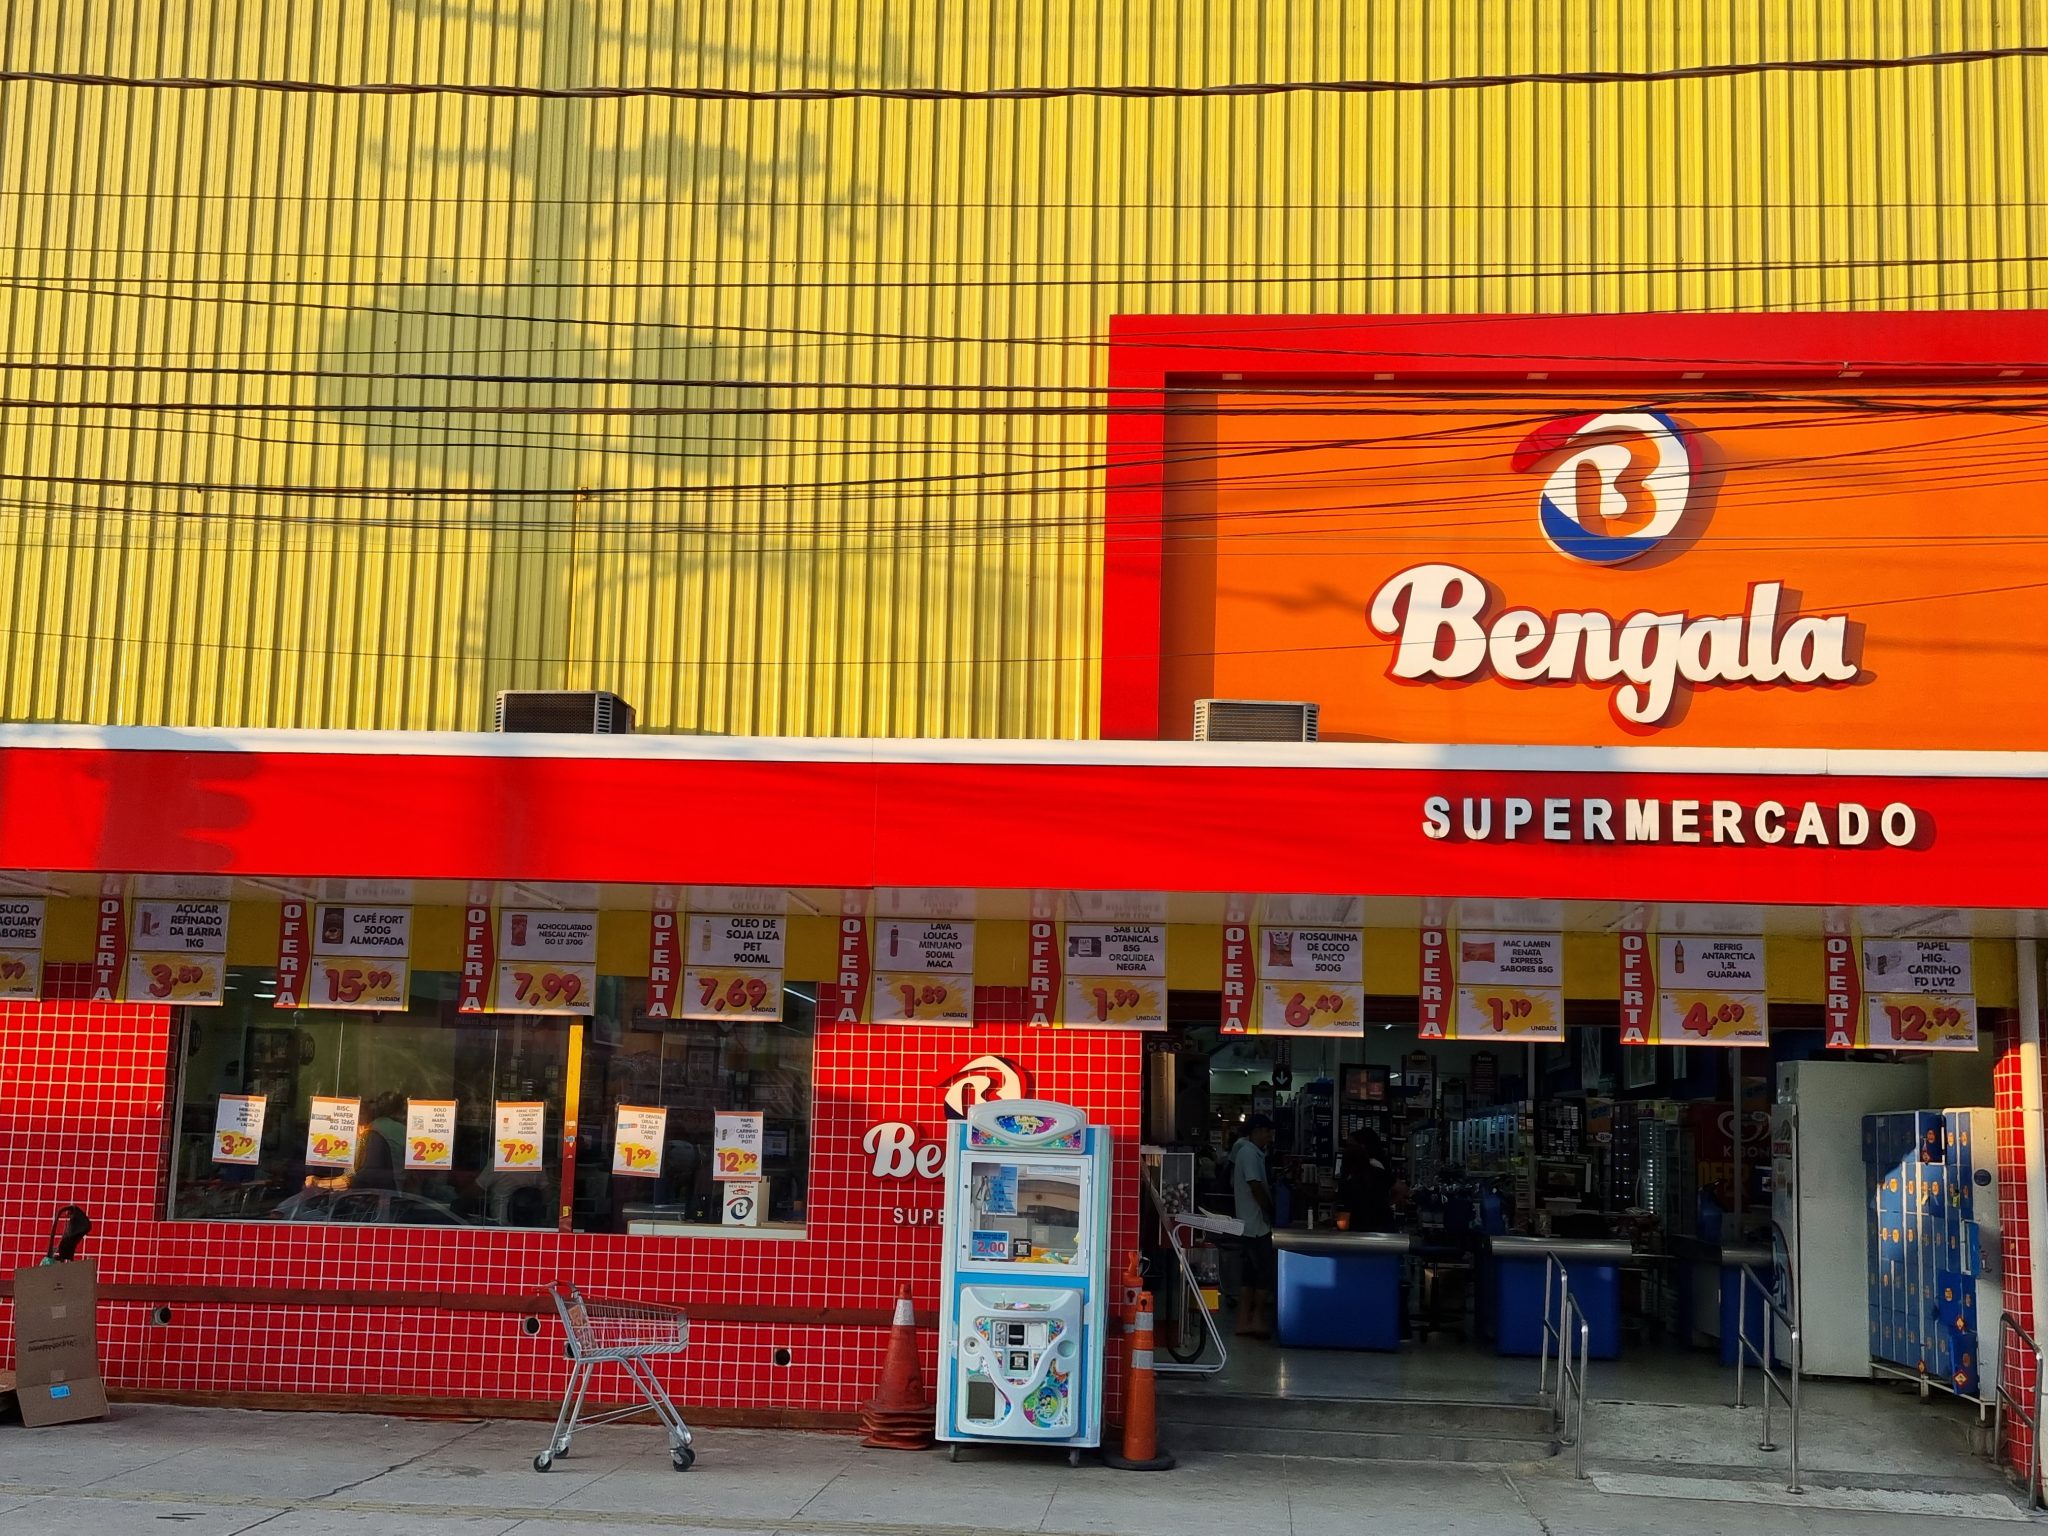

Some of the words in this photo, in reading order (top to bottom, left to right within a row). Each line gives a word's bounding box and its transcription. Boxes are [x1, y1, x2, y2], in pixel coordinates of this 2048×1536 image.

[1368, 562, 1858, 728] Bengala
[1421, 796, 1918, 849] SUPERMERCADO
[176, 904, 218, 915] AÇUCAR
[171, 916, 222, 925] REFINADO
[353, 913, 377, 924] CAFÉ
[379, 915, 404, 924] FORT
[732, 919, 759, 928] OLEO
[763, 920, 776, 929] DE
[170, 927, 184, 936] DA
[187, 927, 222, 937] BARRA
[364, 926, 391, 935] 500G
[726, 930, 754, 940] SOJA
[757, 931, 780, 940] LIZA
[923, 932, 958, 940] LOUCAS
[350, 936, 404, 946] ALMOFADA
[1105, 935, 1159, 944] BOTANICALS
[1300, 933, 1358, 942] ROSQUINHA
[186, 939, 204, 948] 1KG
[744, 942, 762, 951] PET
[919, 941, 962, 950] MINUANO
[1307, 943, 1319, 951] DE
[1322, 943, 1350, 952] COCO
[1714, 943, 1743, 951] REFRIG
[1917, 942, 1951, 951] PAPEL
[92, 900, 119, 1001] OFERTA
[275, 905, 302, 1005] OFERTA
[926, 951, 955, 959] 500ML
[462, 909, 486, 1011] OFERTA
[734, 954, 770, 963] 900ML
[1109, 954, 1155, 962] ORQUIDEA
[1312, 953, 1345, 962] PANCO
[1511, 957, 1544, 965] EXPRESS
[1702, 952, 1756, 961] ANTARCTICA
[1922, 954, 1946, 963] HIG.
[649, 915, 673, 1017] OFERTA
[927, 960, 953, 968] MACA
[1315, 964, 1342, 972] 500G
[1500, 965, 1536, 973] SABORES
[1721, 962, 1737, 970] 1,5L
[838, 919, 861, 1022] OFERTA
[1029, 924, 1051, 1027] OFERTA
[1707, 971, 1752, 979] GUARANA
[1908, 965, 1961, 975] CARINHO
[326, 969, 392, 1002] 15,99
[1223, 928, 1245, 1032] OFERTA
[1421, 932, 1443, 1037] OFERTA
[1914, 977, 1929, 987] FD
[1932, 977, 1956, 987] LV12
[514, 973, 582, 1006] 7,99
[1622, 936, 1645, 1042] OFERTA
[1827, 939, 1851, 1046] OFERTA
[699, 978, 767, 1012] 7,69
[900, 985, 947, 1018] 1,89
[1092, 987, 1140, 1022] 1,99
[1285, 993, 1344, 1028] 6,49
[1487, 998, 1533, 1032] 1,19
[1682, 1002, 1745, 1037] 4,69
[1884, 1005, 1961, 1041] 12,99
[221, 1135, 253, 1155] 3,79
[313, 1138, 348, 1157] 4,99
[862, 1121, 946, 1180] Be
[413, 1142, 445, 1161] 2,99
[504, 1144, 534, 1163] 7,99
[625, 1148, 652, 1167] 1,99
[718, 1152, 758, 1173] 12,99
[893, 1207, 945, 1226] SUPE
